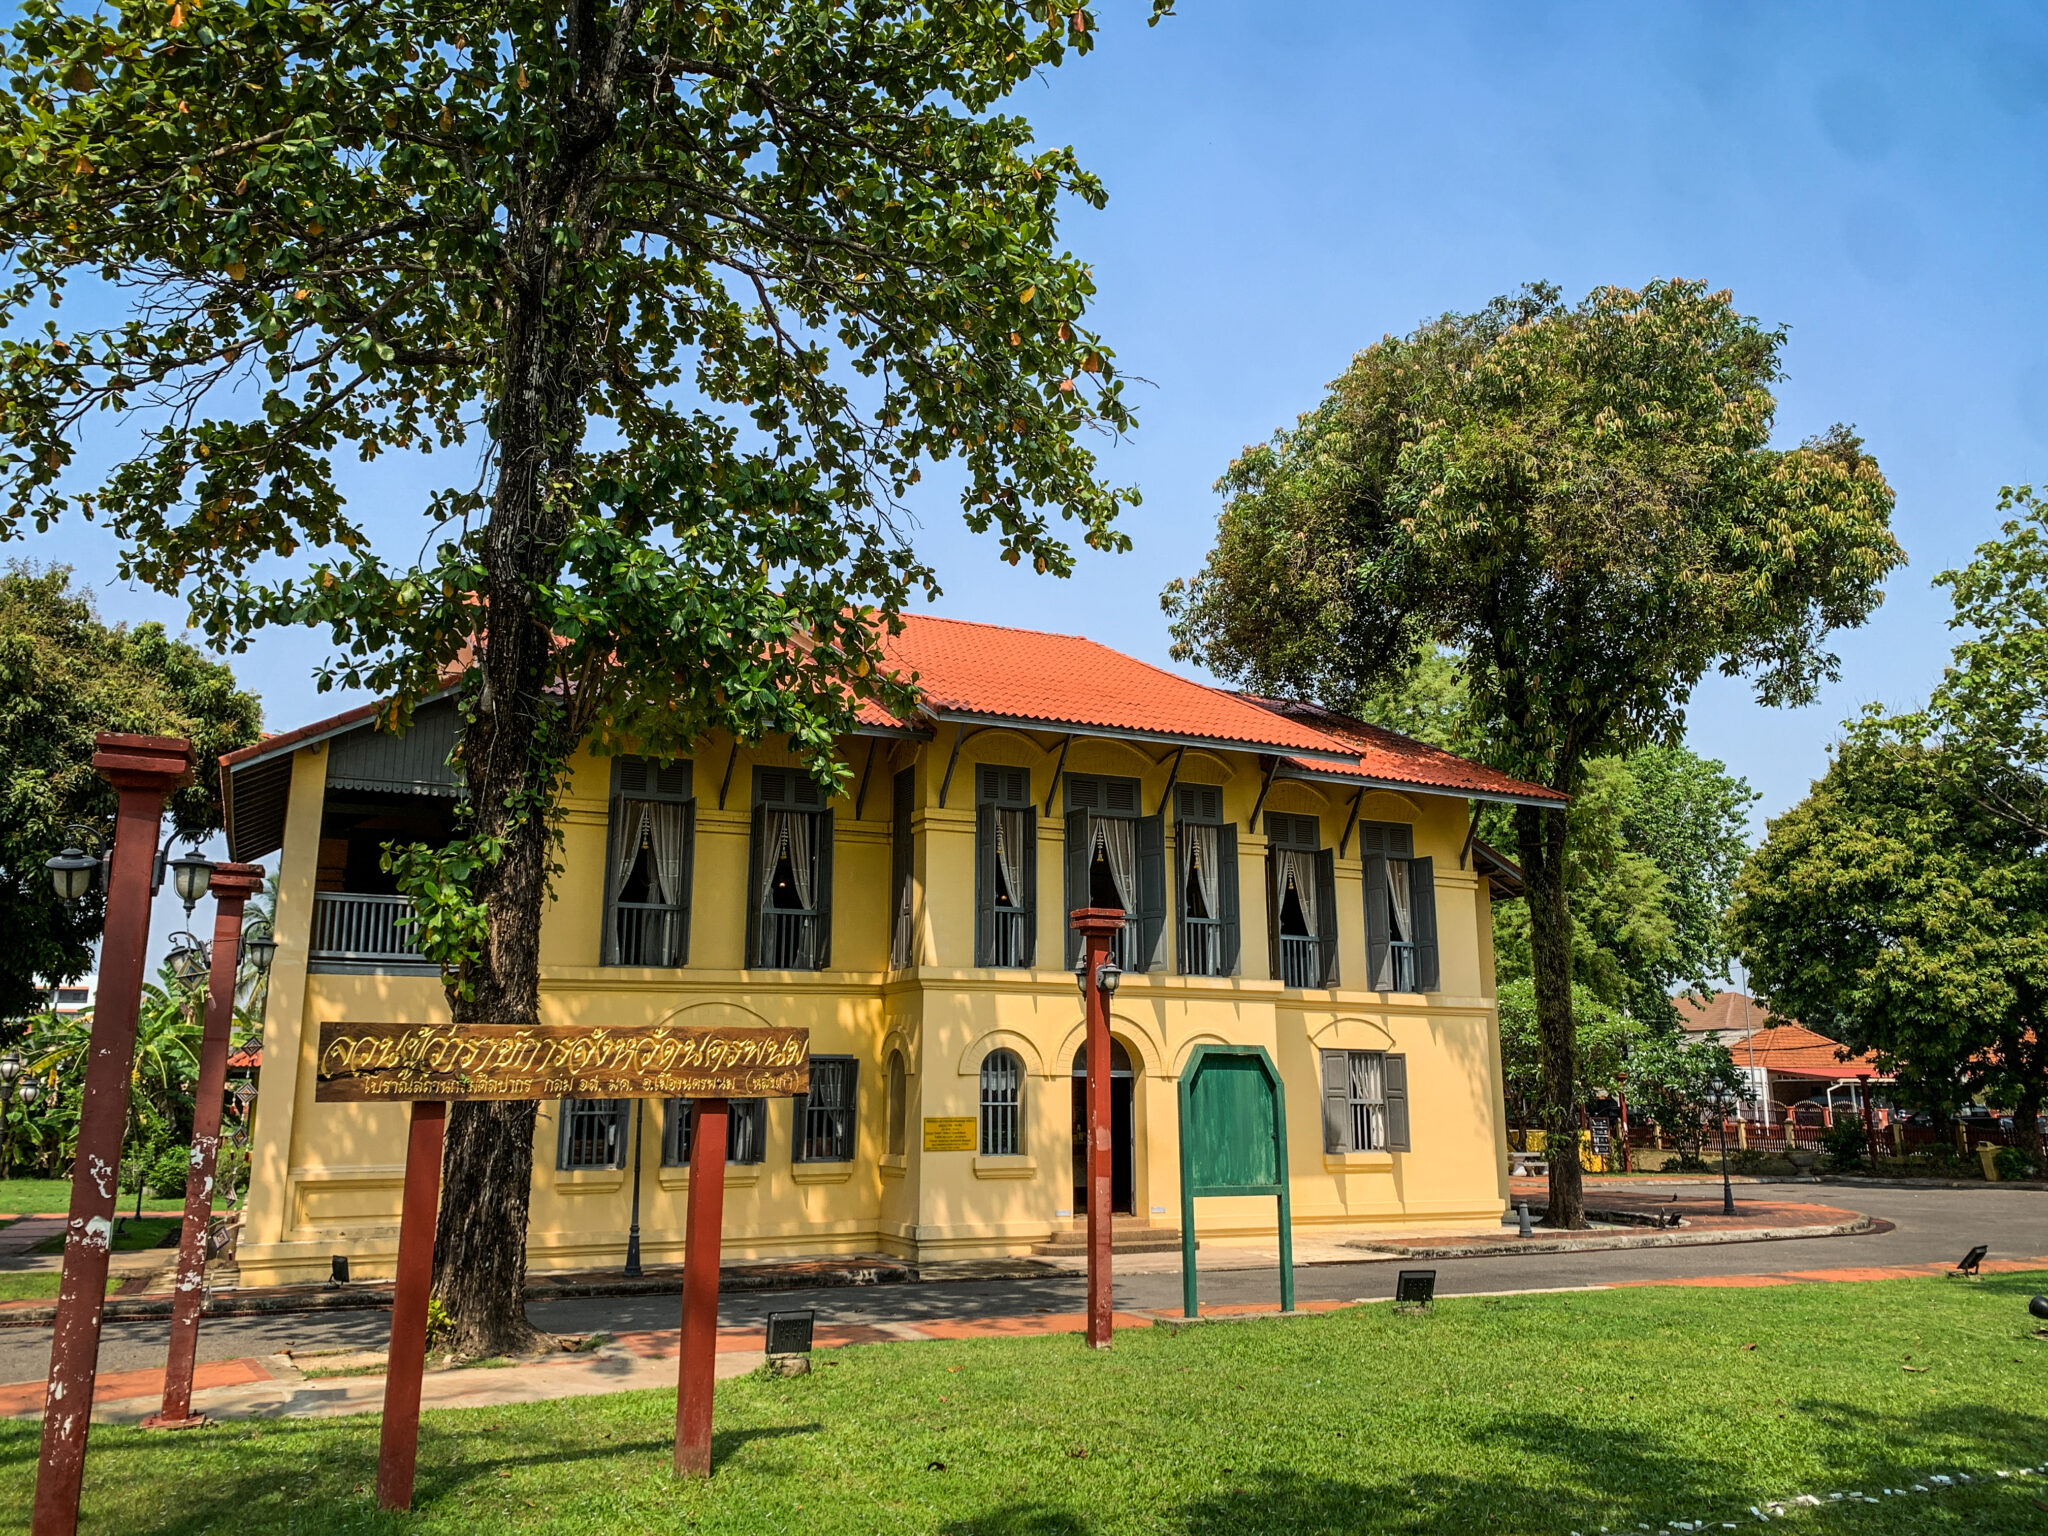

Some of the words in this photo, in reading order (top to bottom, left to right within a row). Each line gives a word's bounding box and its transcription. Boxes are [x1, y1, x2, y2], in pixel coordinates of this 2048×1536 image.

[321, 1025, 809, 1079] จวนผู้ว่าราชการจังหวัดนครพนม
[544, 1073, 573, 1099] กลุ่ม
